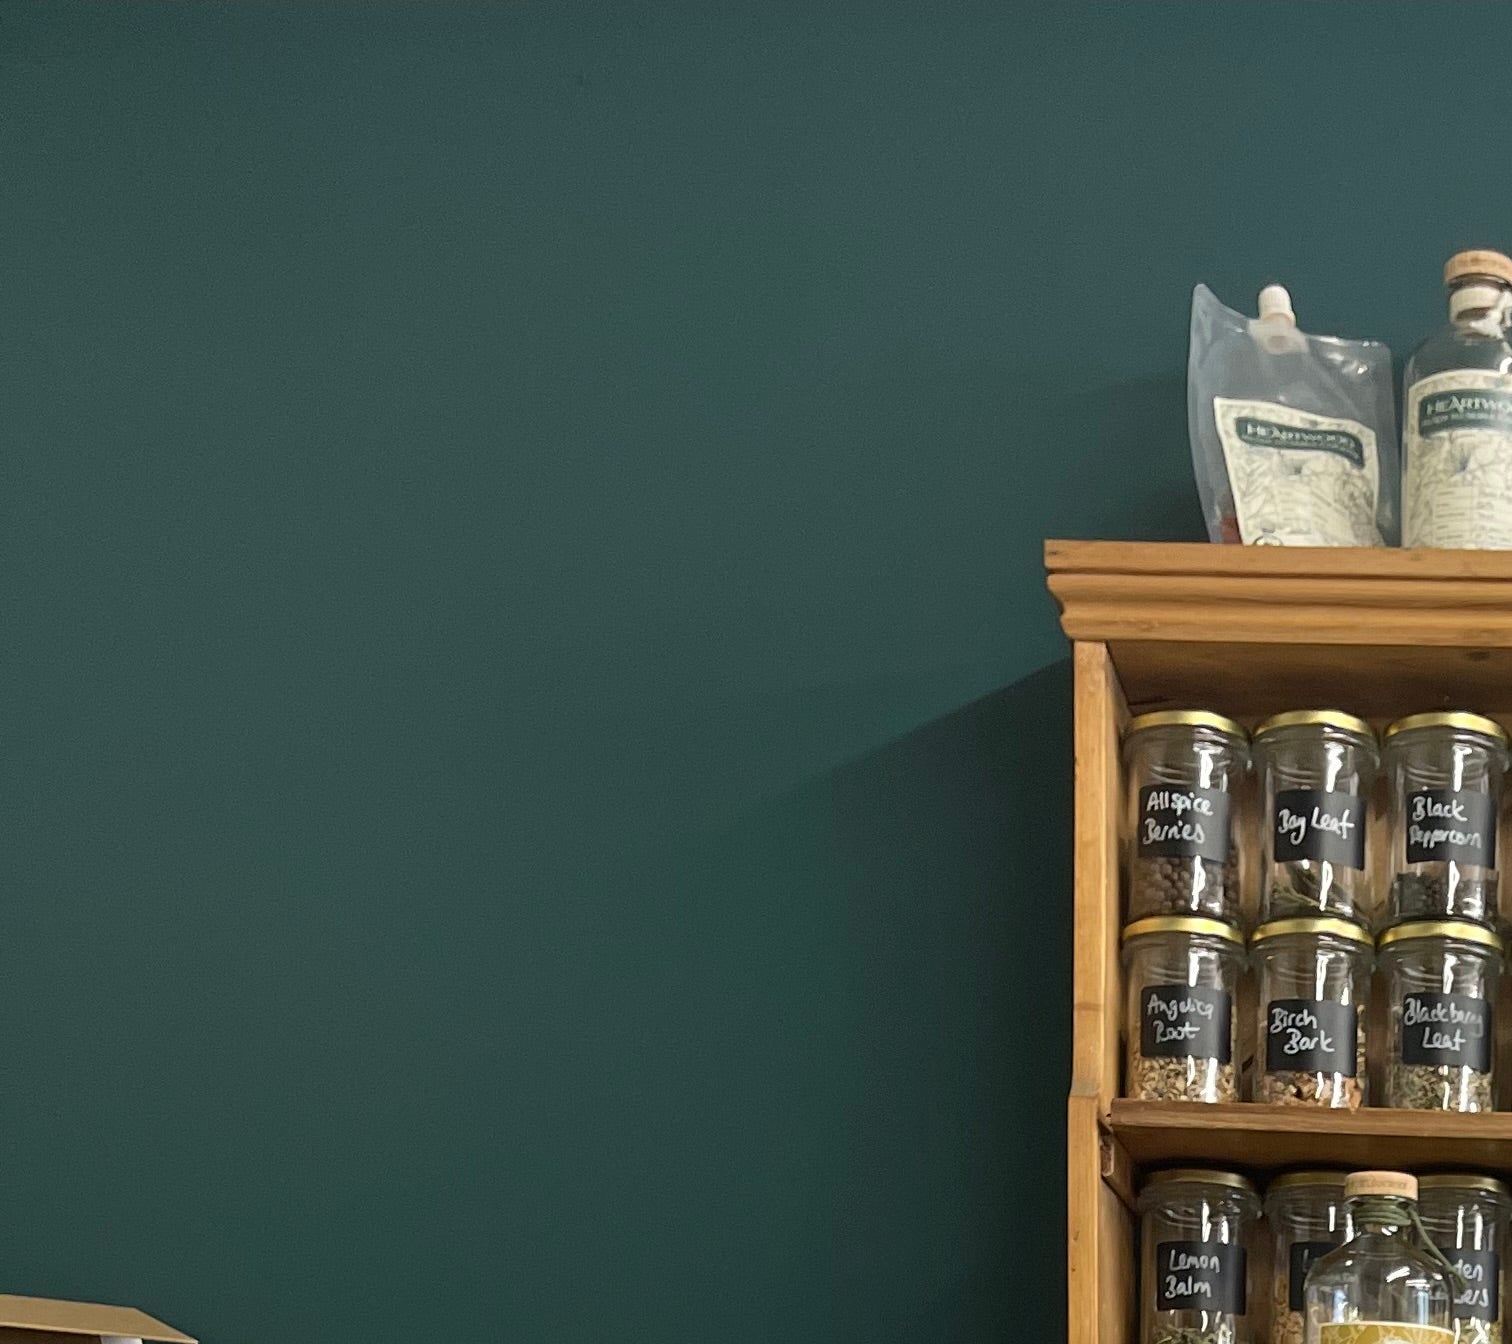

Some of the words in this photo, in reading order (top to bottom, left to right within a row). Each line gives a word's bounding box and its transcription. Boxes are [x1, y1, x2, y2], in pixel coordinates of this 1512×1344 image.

[1146, 790, 1214, 817] Allspice
[1411, 796, 1468, 821] Black
[1140, 817, 1207, 845] Berries
[1277, 808, 1308, 843] Bay
[1311, 807, 1355, 841] Leaf
[1408, 821, 1483, 850] Peppercorn
[1145, 996, 1216, 1024] Angelica
[1269, 1006, 1318, 1034] Birch
[1403, 997, 1484, 1037] Blackberry
[1152, 1017, 1201, 1044] Root
[1281, 1028, 1336, 1054] Bark
[1421, 1026, 1467, 1052] Leaf
[1168, 1249, 1221, 1273] Lemon
[1164, 1275, 1213, 1300] Balm
